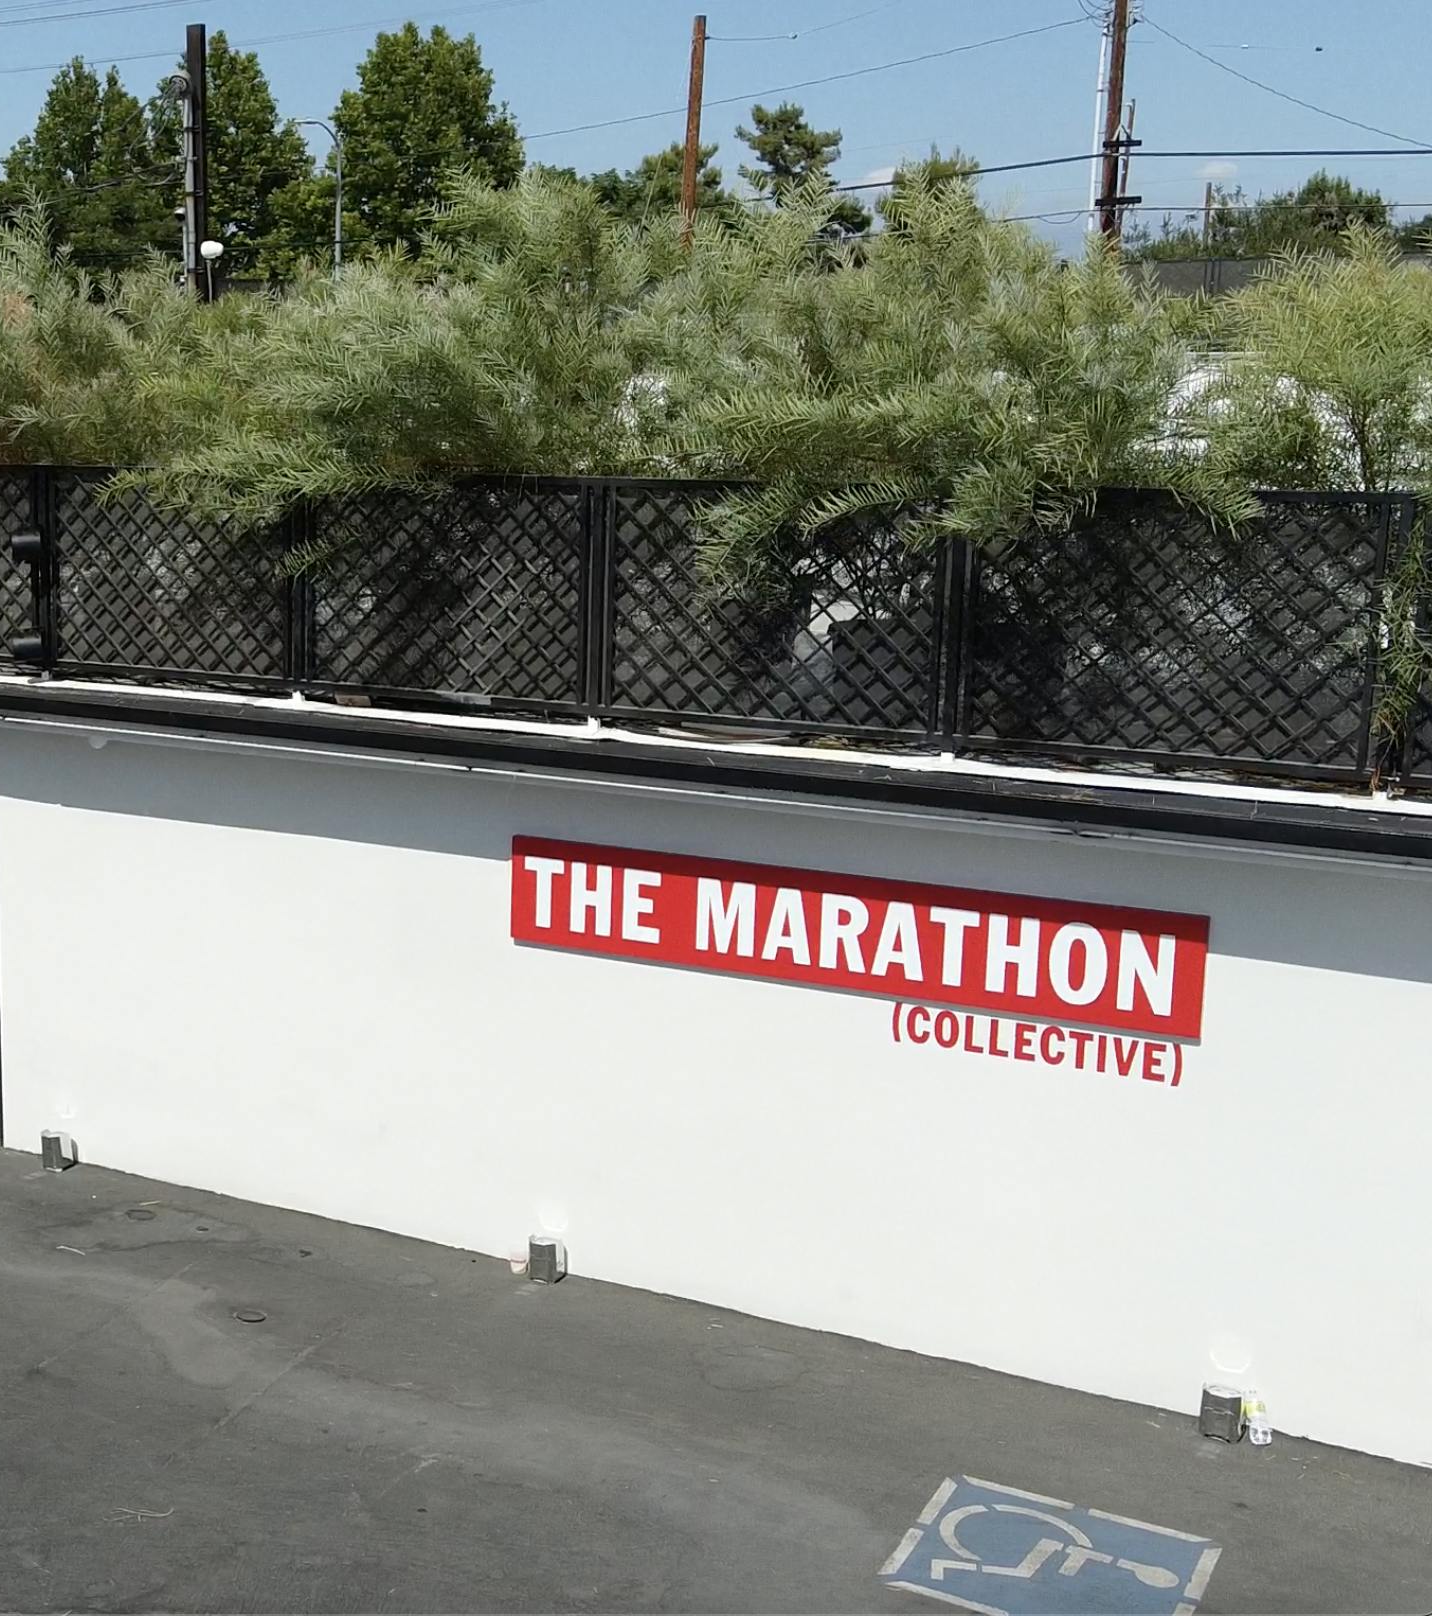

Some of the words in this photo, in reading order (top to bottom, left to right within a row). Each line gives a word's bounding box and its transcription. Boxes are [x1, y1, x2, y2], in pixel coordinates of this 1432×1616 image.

[524, 855, 661, 944] THE
[695, 877, 1176, 1017] MARATHON
[892, 1002, 1183, 1087] (COLLECTIVE)
